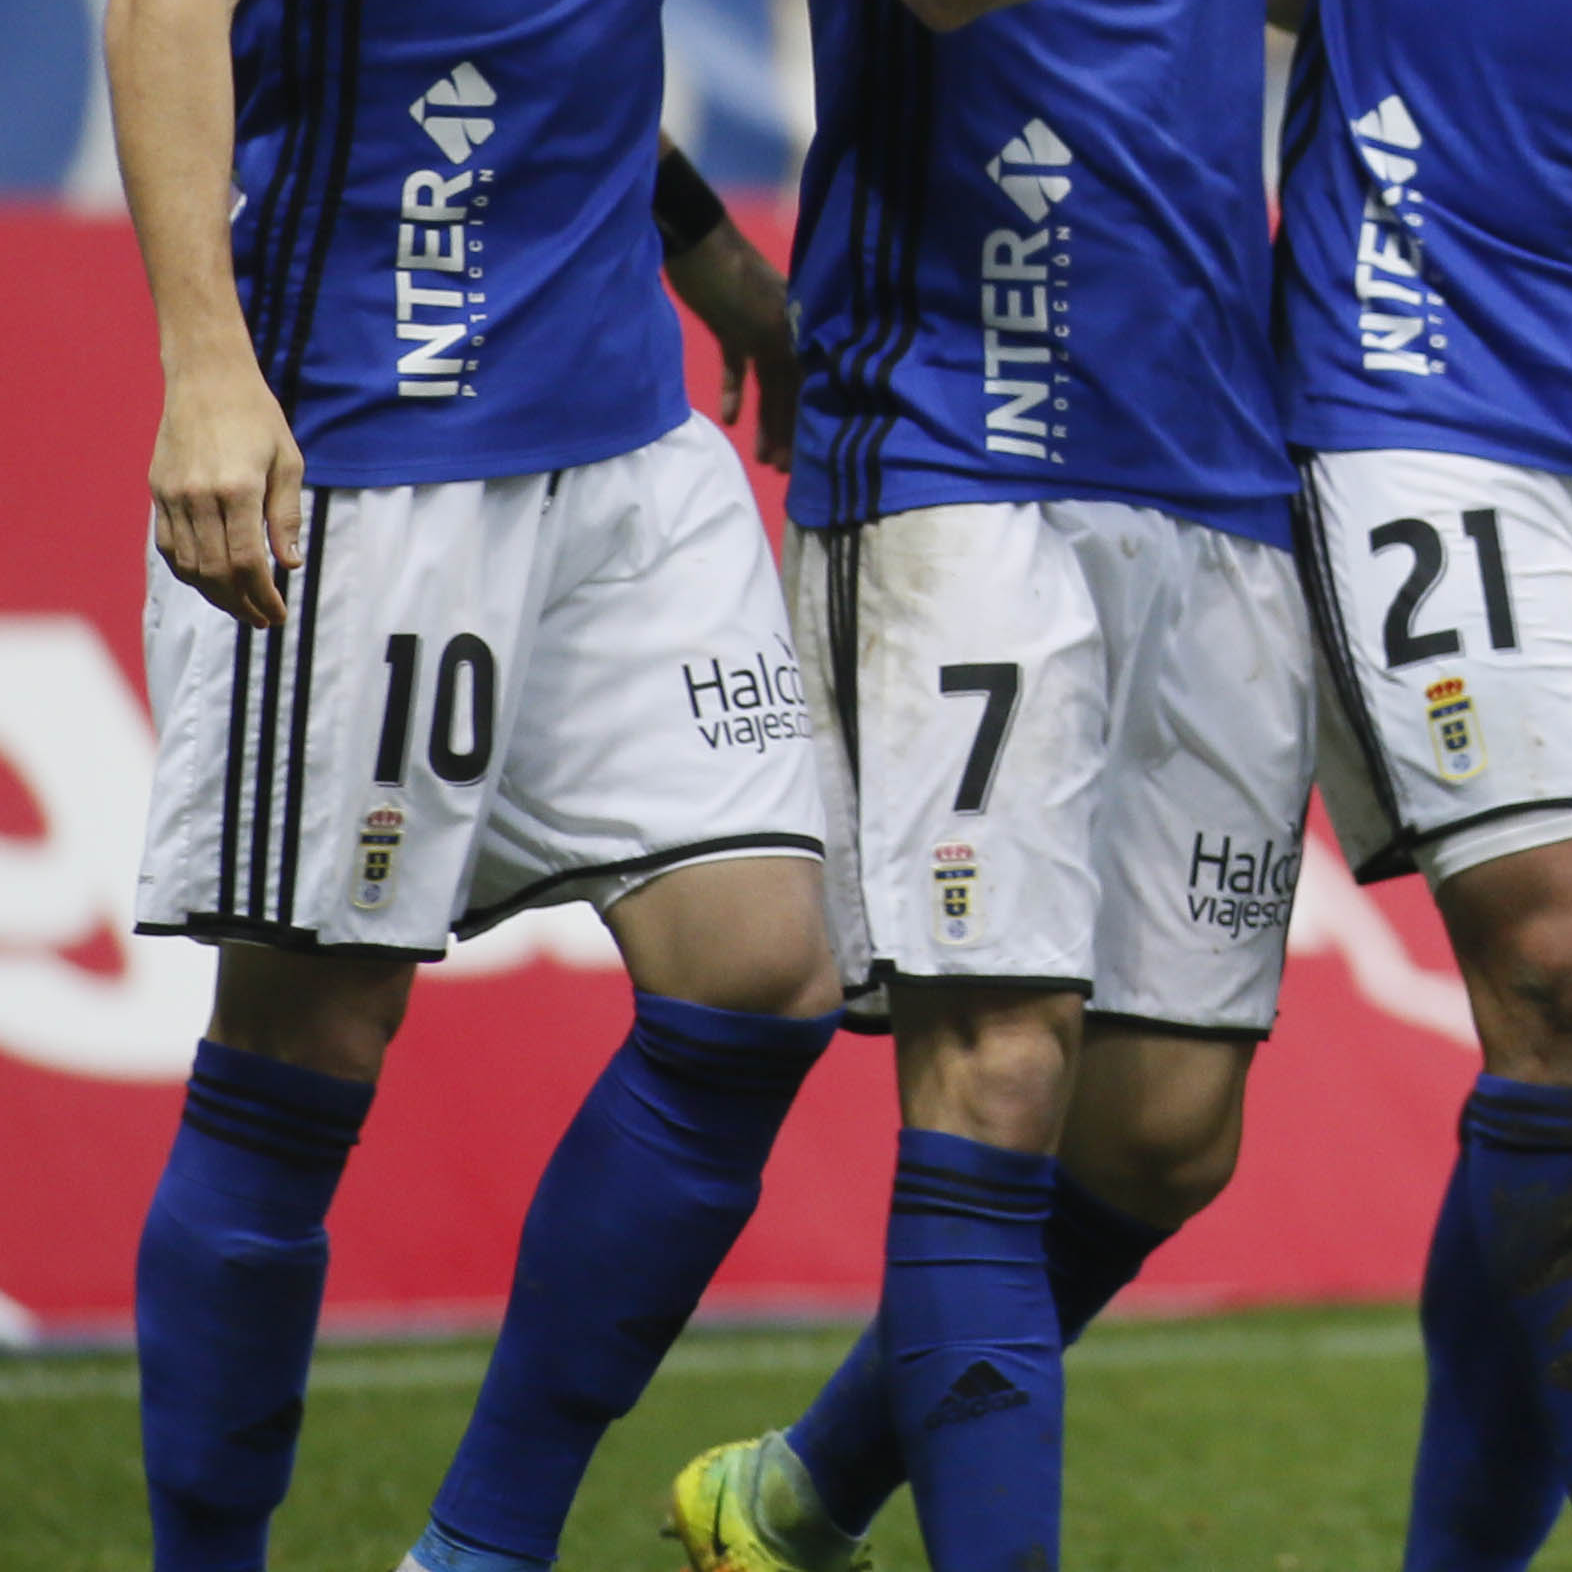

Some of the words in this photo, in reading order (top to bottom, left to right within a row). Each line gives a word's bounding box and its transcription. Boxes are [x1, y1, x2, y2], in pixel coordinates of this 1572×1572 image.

[396, 169, 474, 398] INTER
[981, 228, 1050, 460] INTER
[1369, 507, 1520, 669] 21
[374, 633, 494, 788] 10
[939, 662, 1022, 816] 7
